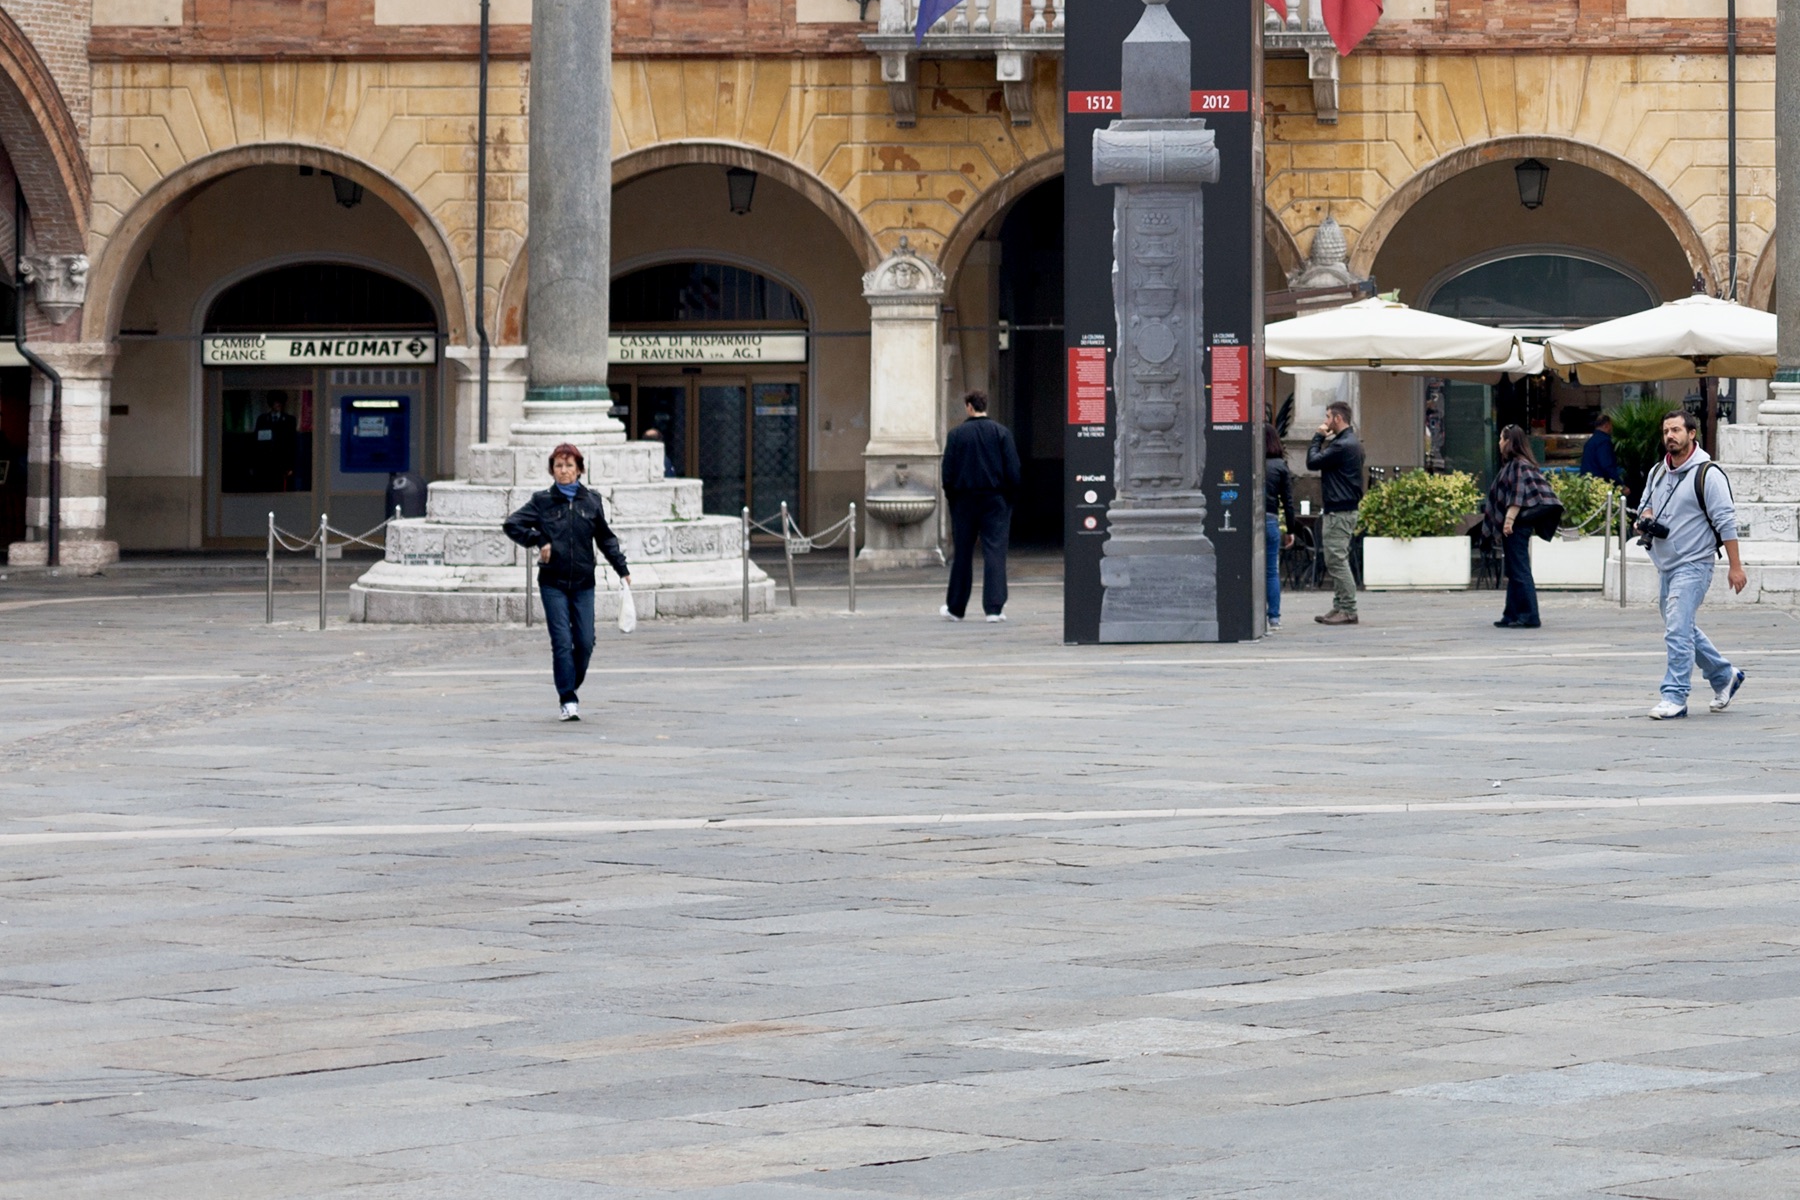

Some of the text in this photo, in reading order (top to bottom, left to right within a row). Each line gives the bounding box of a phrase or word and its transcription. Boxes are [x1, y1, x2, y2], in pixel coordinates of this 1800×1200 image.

[1086, 95, 1113, 110] 1512
[1202, 94, 1230, 109] 2012
[211, 338, 265, 349] CAMBIO
[619, 335, 762, 347] CASSA DI RISPARMIO
[289, 340, 402, 357] BANCOMAT
[620, 349, 634, 359] DI
[641, 348, 704, 359] RAVENNA
[211, 350, 266, 361] CHANGE
